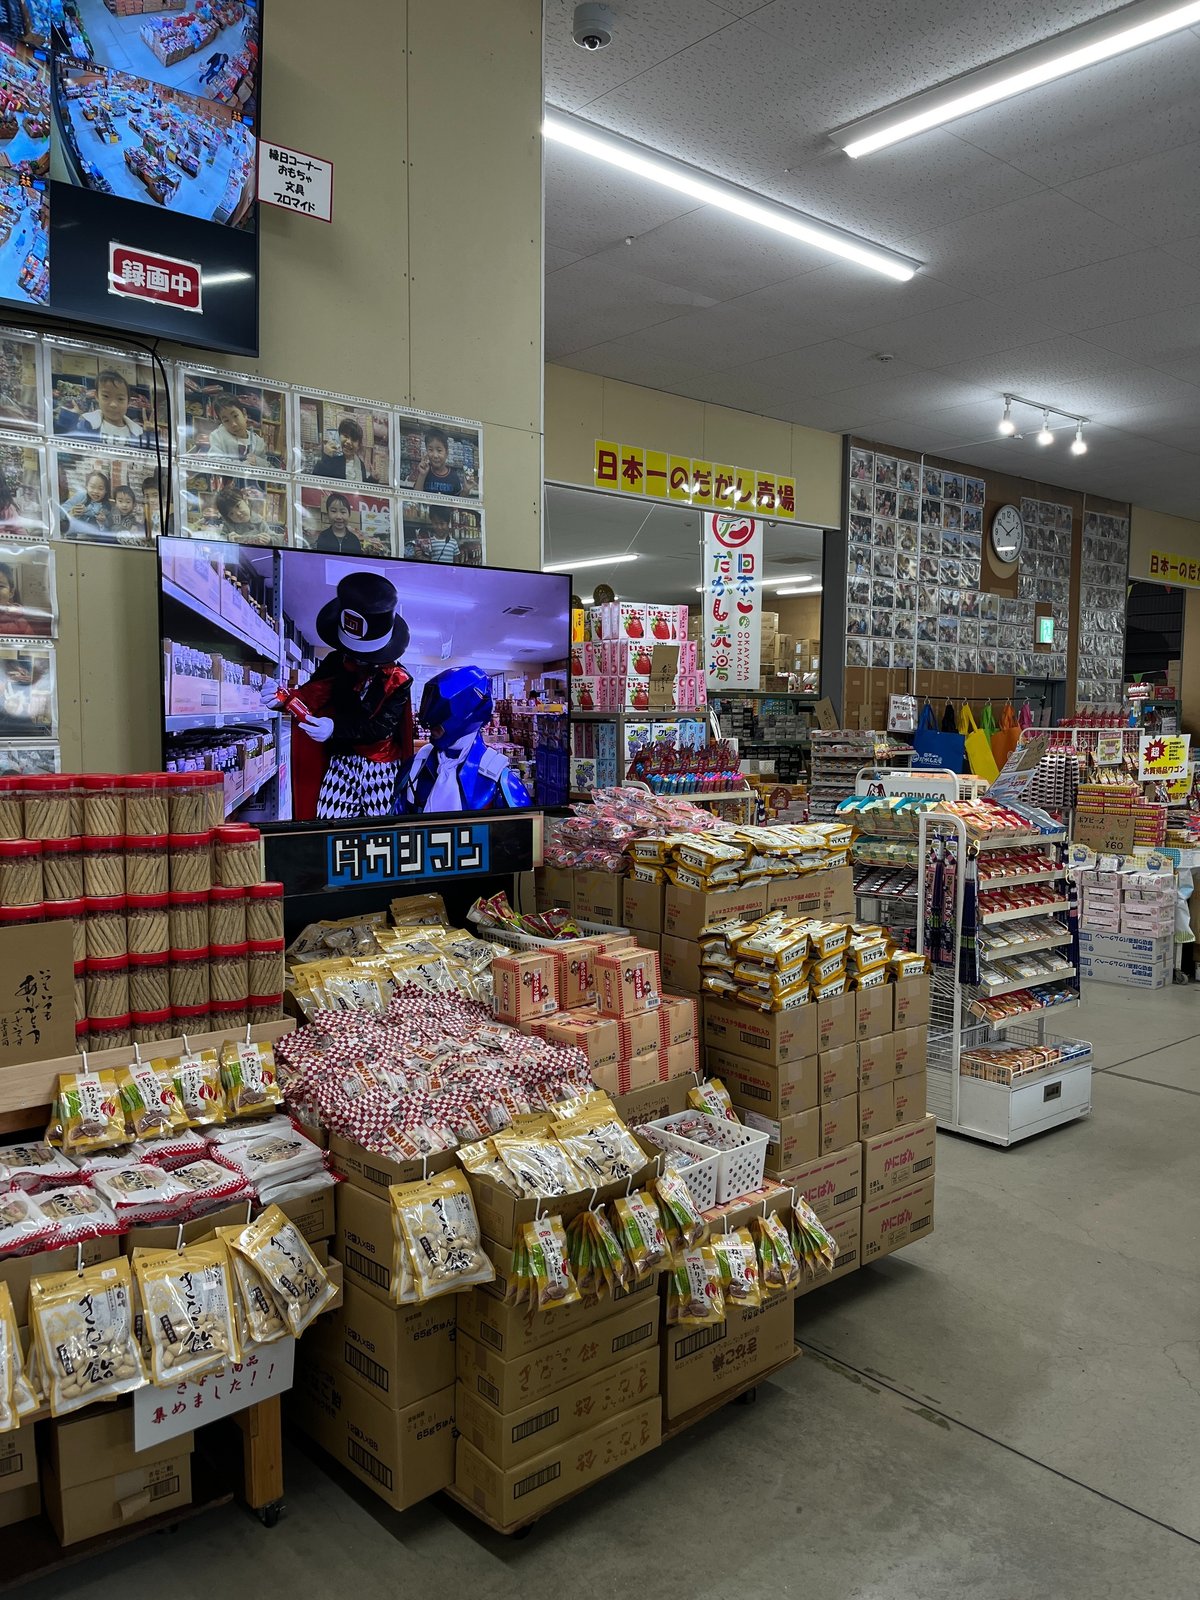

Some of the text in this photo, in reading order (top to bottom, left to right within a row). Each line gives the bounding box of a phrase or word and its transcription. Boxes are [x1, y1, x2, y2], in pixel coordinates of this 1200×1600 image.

[269, 148, 322, 171] 縁日コーナー
[278, 165, 312, 183] おもちゃ
[285, 181, 304, 196] 文具
[273, 192, 315, 212] ブロマイド
[121, 259, 192, 297] 録画中
[597, 449, 795, 513] 日本一のだがし売場
[620, 608, 645, 616] いちご
[647, 610, 671, 618] いちご
[629, 729, 649, 738] グレープ
[657, 729, 678, 738] グレープ
[1151, 746, 1160, 758] 超
[1142, 765, 1185, 775] お買得品ワゴン
[1105, 840, 1123, 850] ¥60
[825, 938, 845, 949] カステラ
[785, 947, 806, 962] カステラ
[823, 962, 840, 976] カステラ
[781, 970, 803, 986] カステラ
[864, 975, 883, 987] カステラ
[822, 985, 843, 998] カステラ
[785, 993, 807, 1008] カステラ
[142, 1077, 163, 1113] ねりきなこ
[85, 1086, 100, 1122] ねりきなこ
[884, 1148, 915, 1172] かにぱん
[880, 1208, 913, 1233] かにぱん
[270, 1236, 321, 1300] きなこ飴
[544, 1237, 562, 1285] ねりきなこ
[692, 1263, 704, 1304] ねりきなこ
[179, 1271, 214, 1353] きなこ飴
[78, 1293, 114, 1384] きなこ飴
[535, 1346, 572, 1368] やわらか
